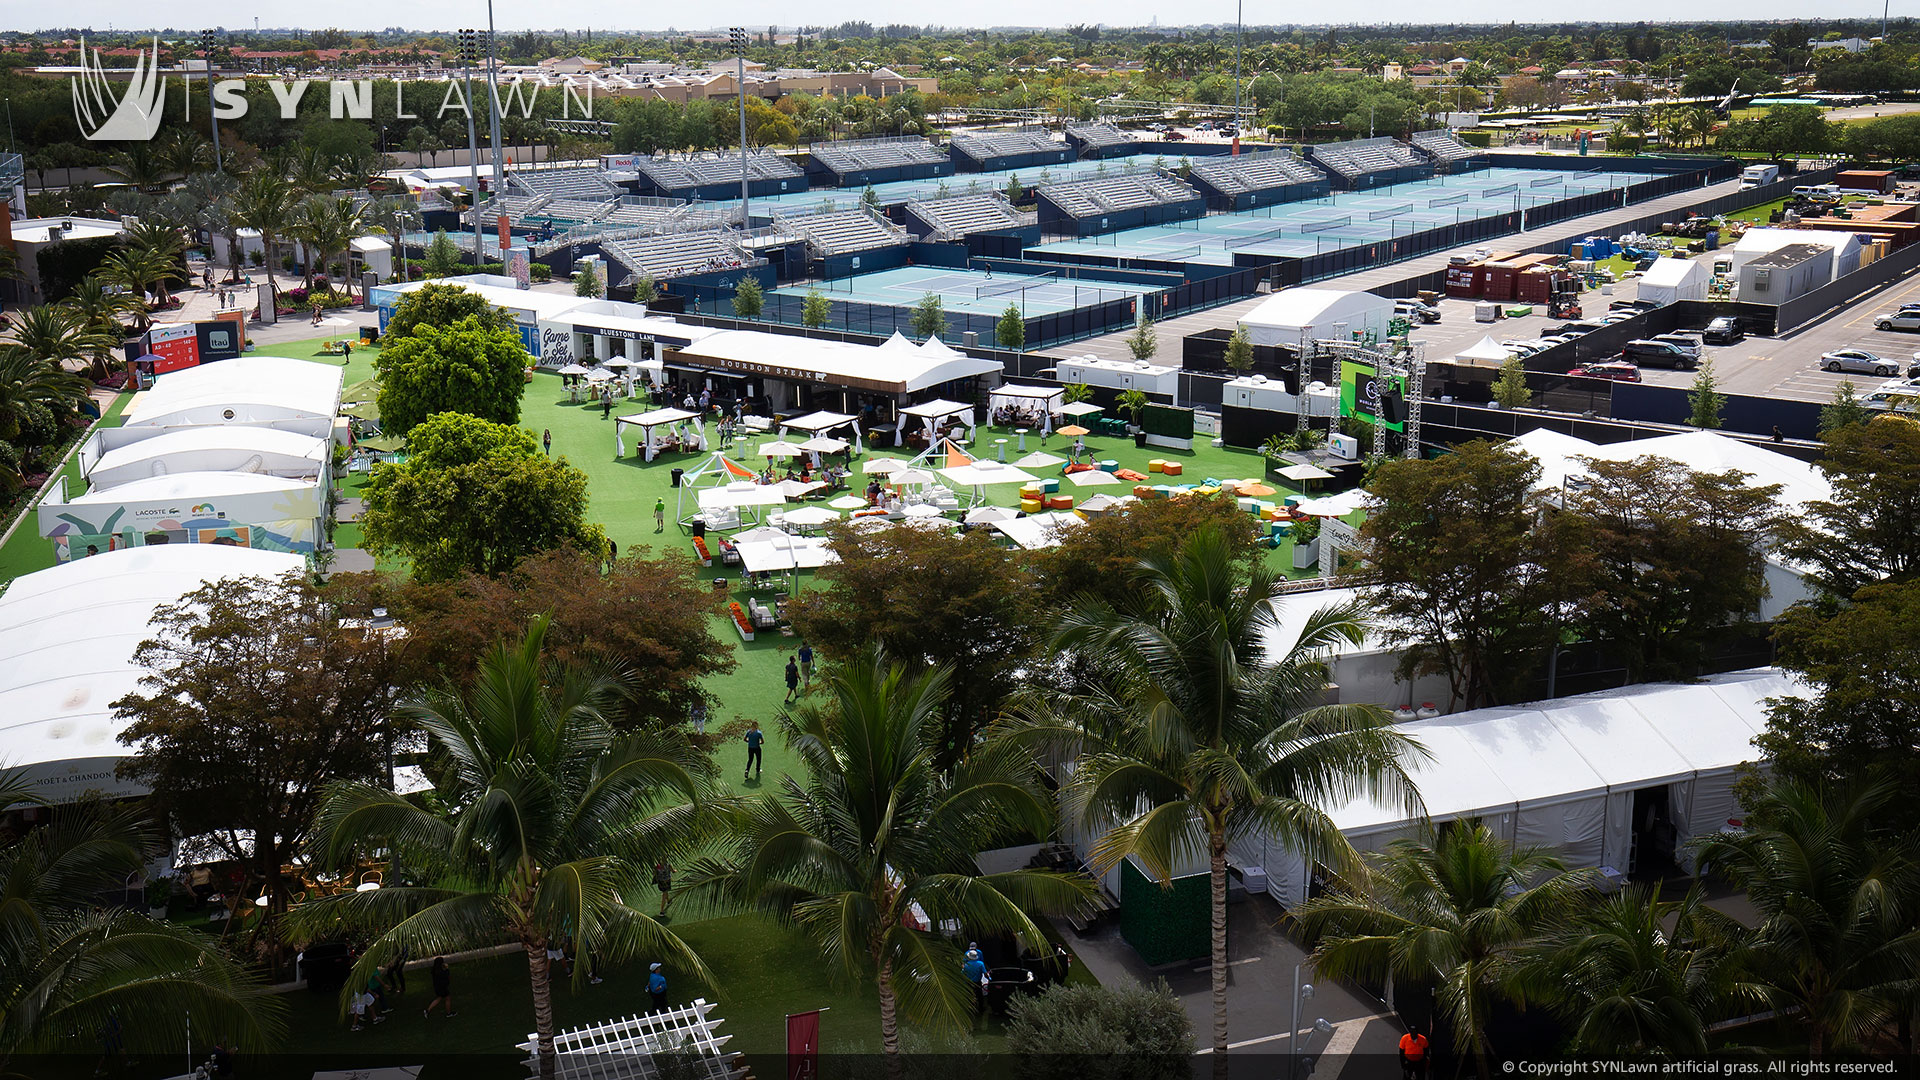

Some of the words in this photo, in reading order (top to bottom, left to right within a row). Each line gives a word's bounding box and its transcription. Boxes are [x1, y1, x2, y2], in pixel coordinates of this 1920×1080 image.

[543, 328, 570, 348] Game
[600, 328, 635, 339] BLUESTONE
[639, 333, 656, 342] LANE
[551, 341, 568, 356] Set
[541, 350, 575, 366] Smash
[720, 359, 770, 373] BOURBON
[776, 367, 812, 379] STEAK
[69, 771, 111, 783] CHANDON
